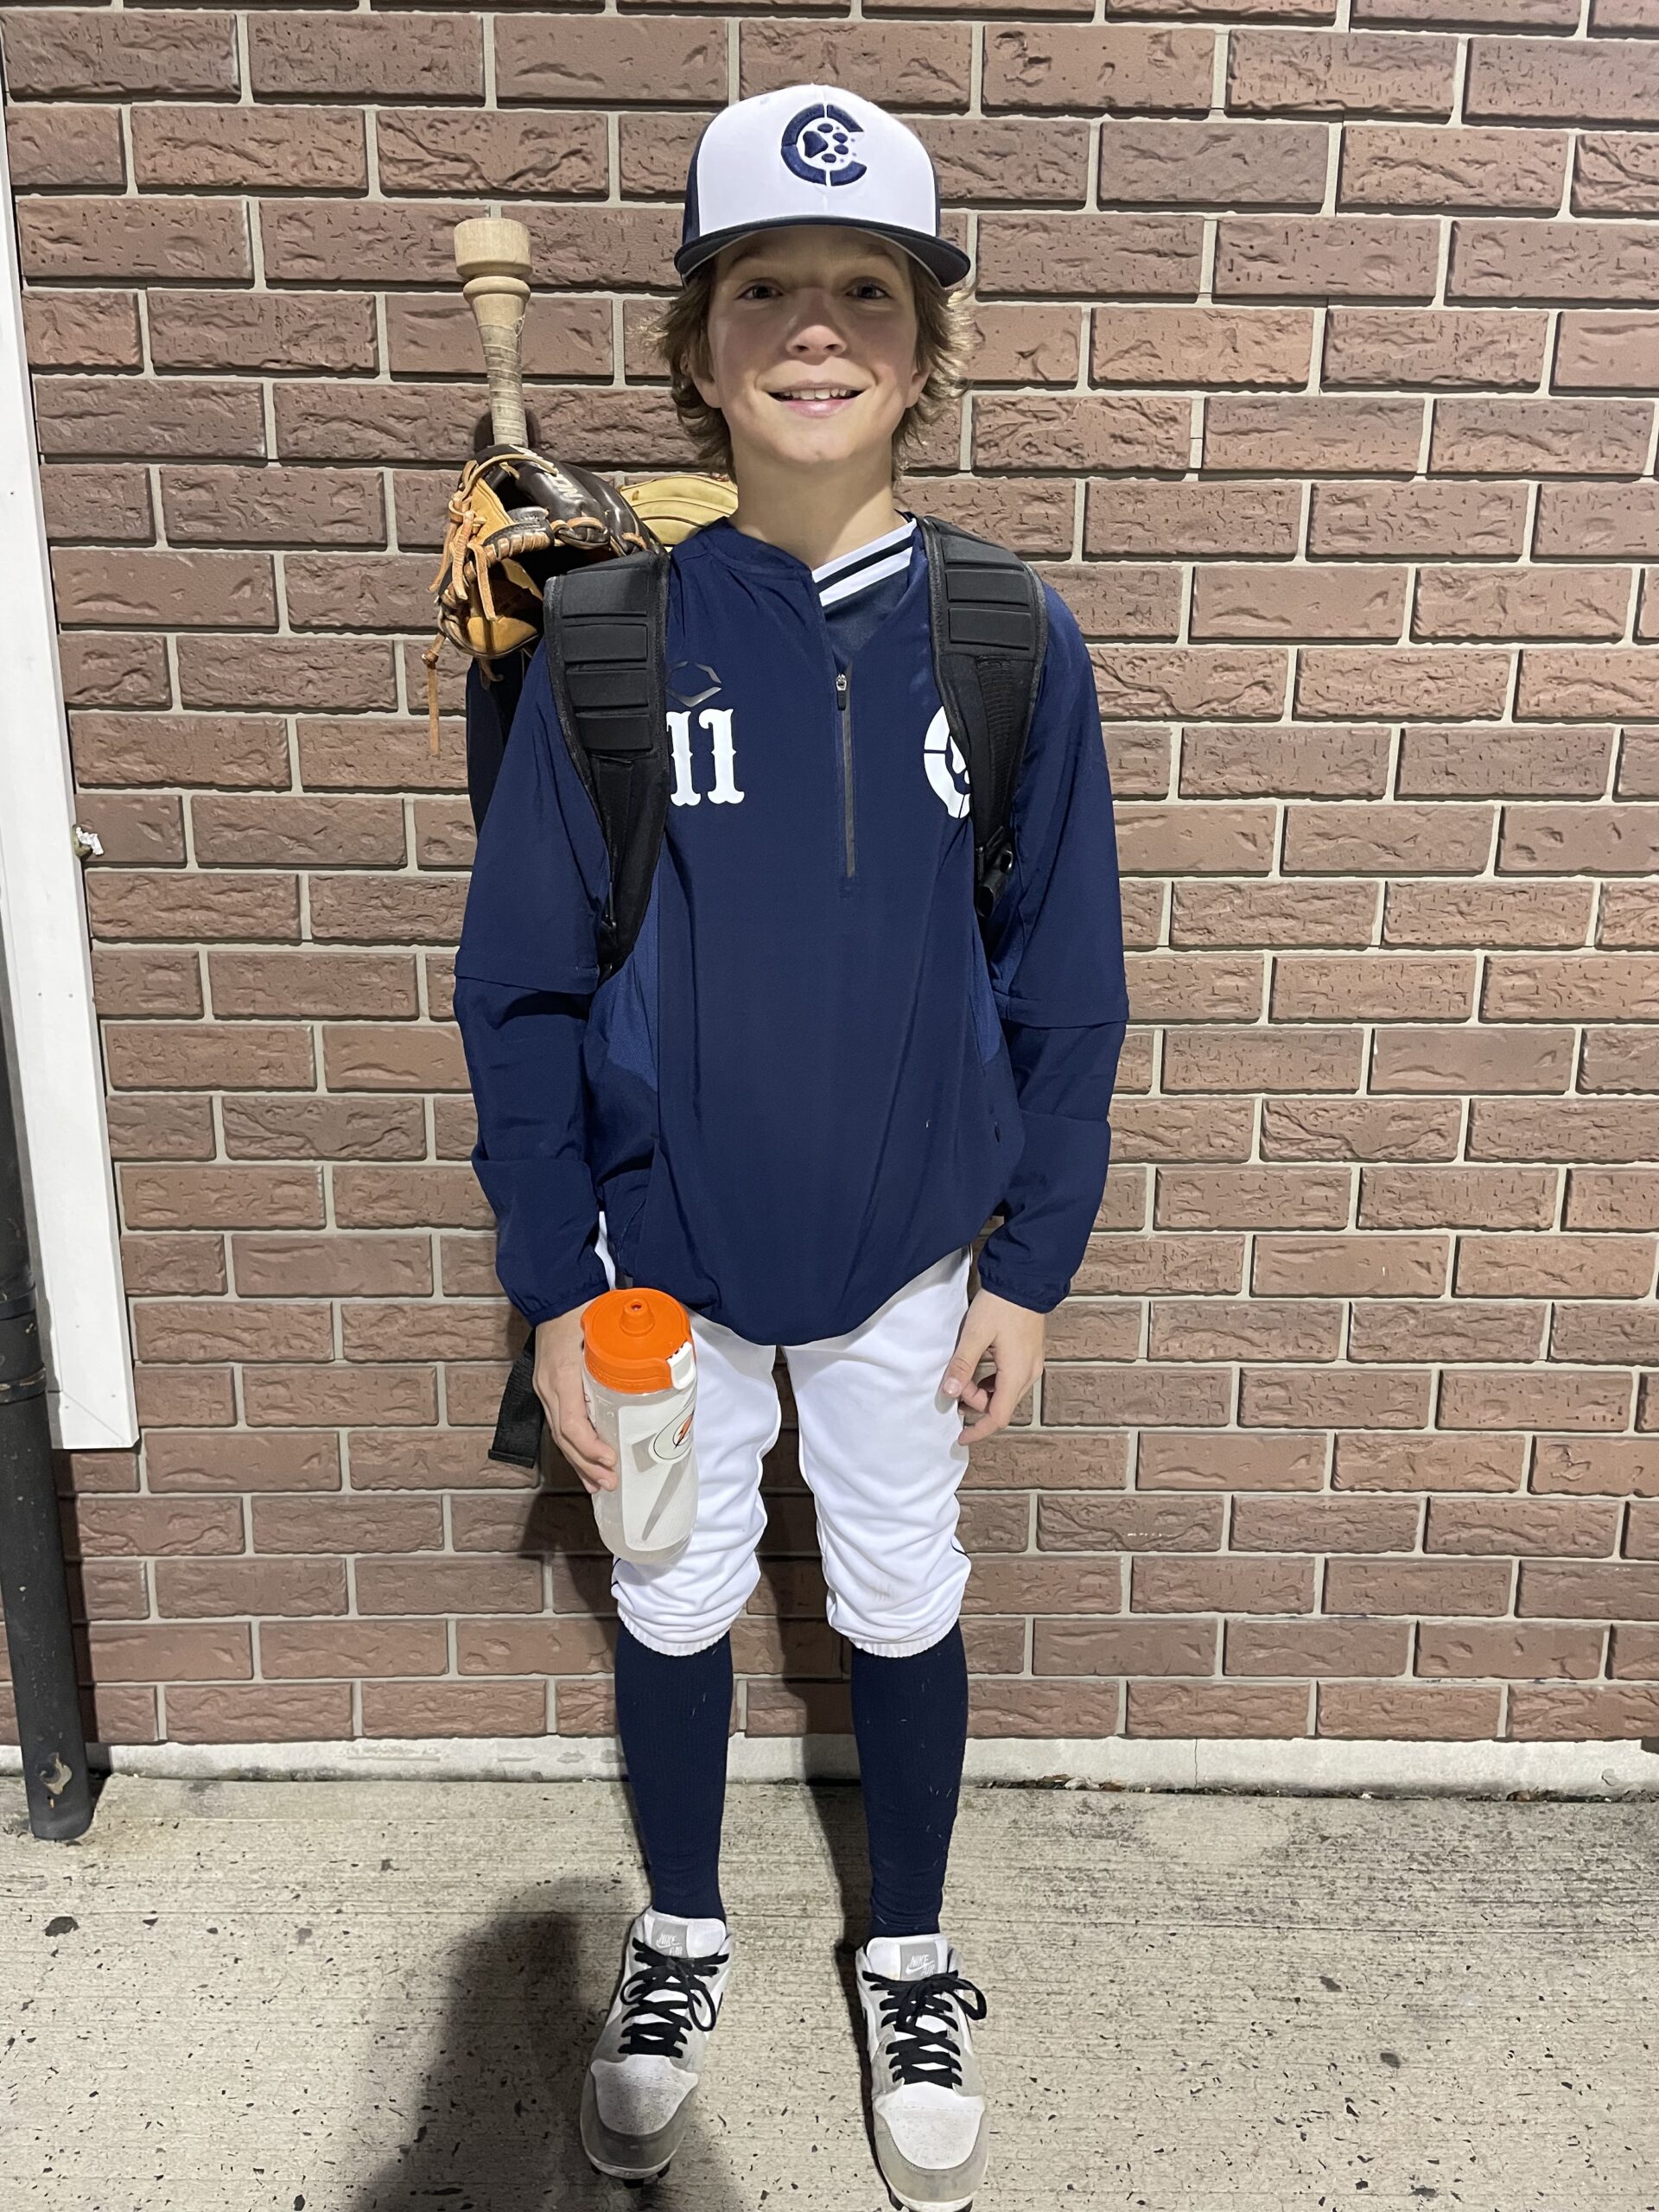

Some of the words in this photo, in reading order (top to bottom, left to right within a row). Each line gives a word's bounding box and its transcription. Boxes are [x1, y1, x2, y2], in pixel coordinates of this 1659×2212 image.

[666, 709, 745, 806] 11
[658, 1934, 677, 1946] NIKE
[910, 1954, 930, 1968] NIKE
[920, 1962, 935, 1976] AIR
